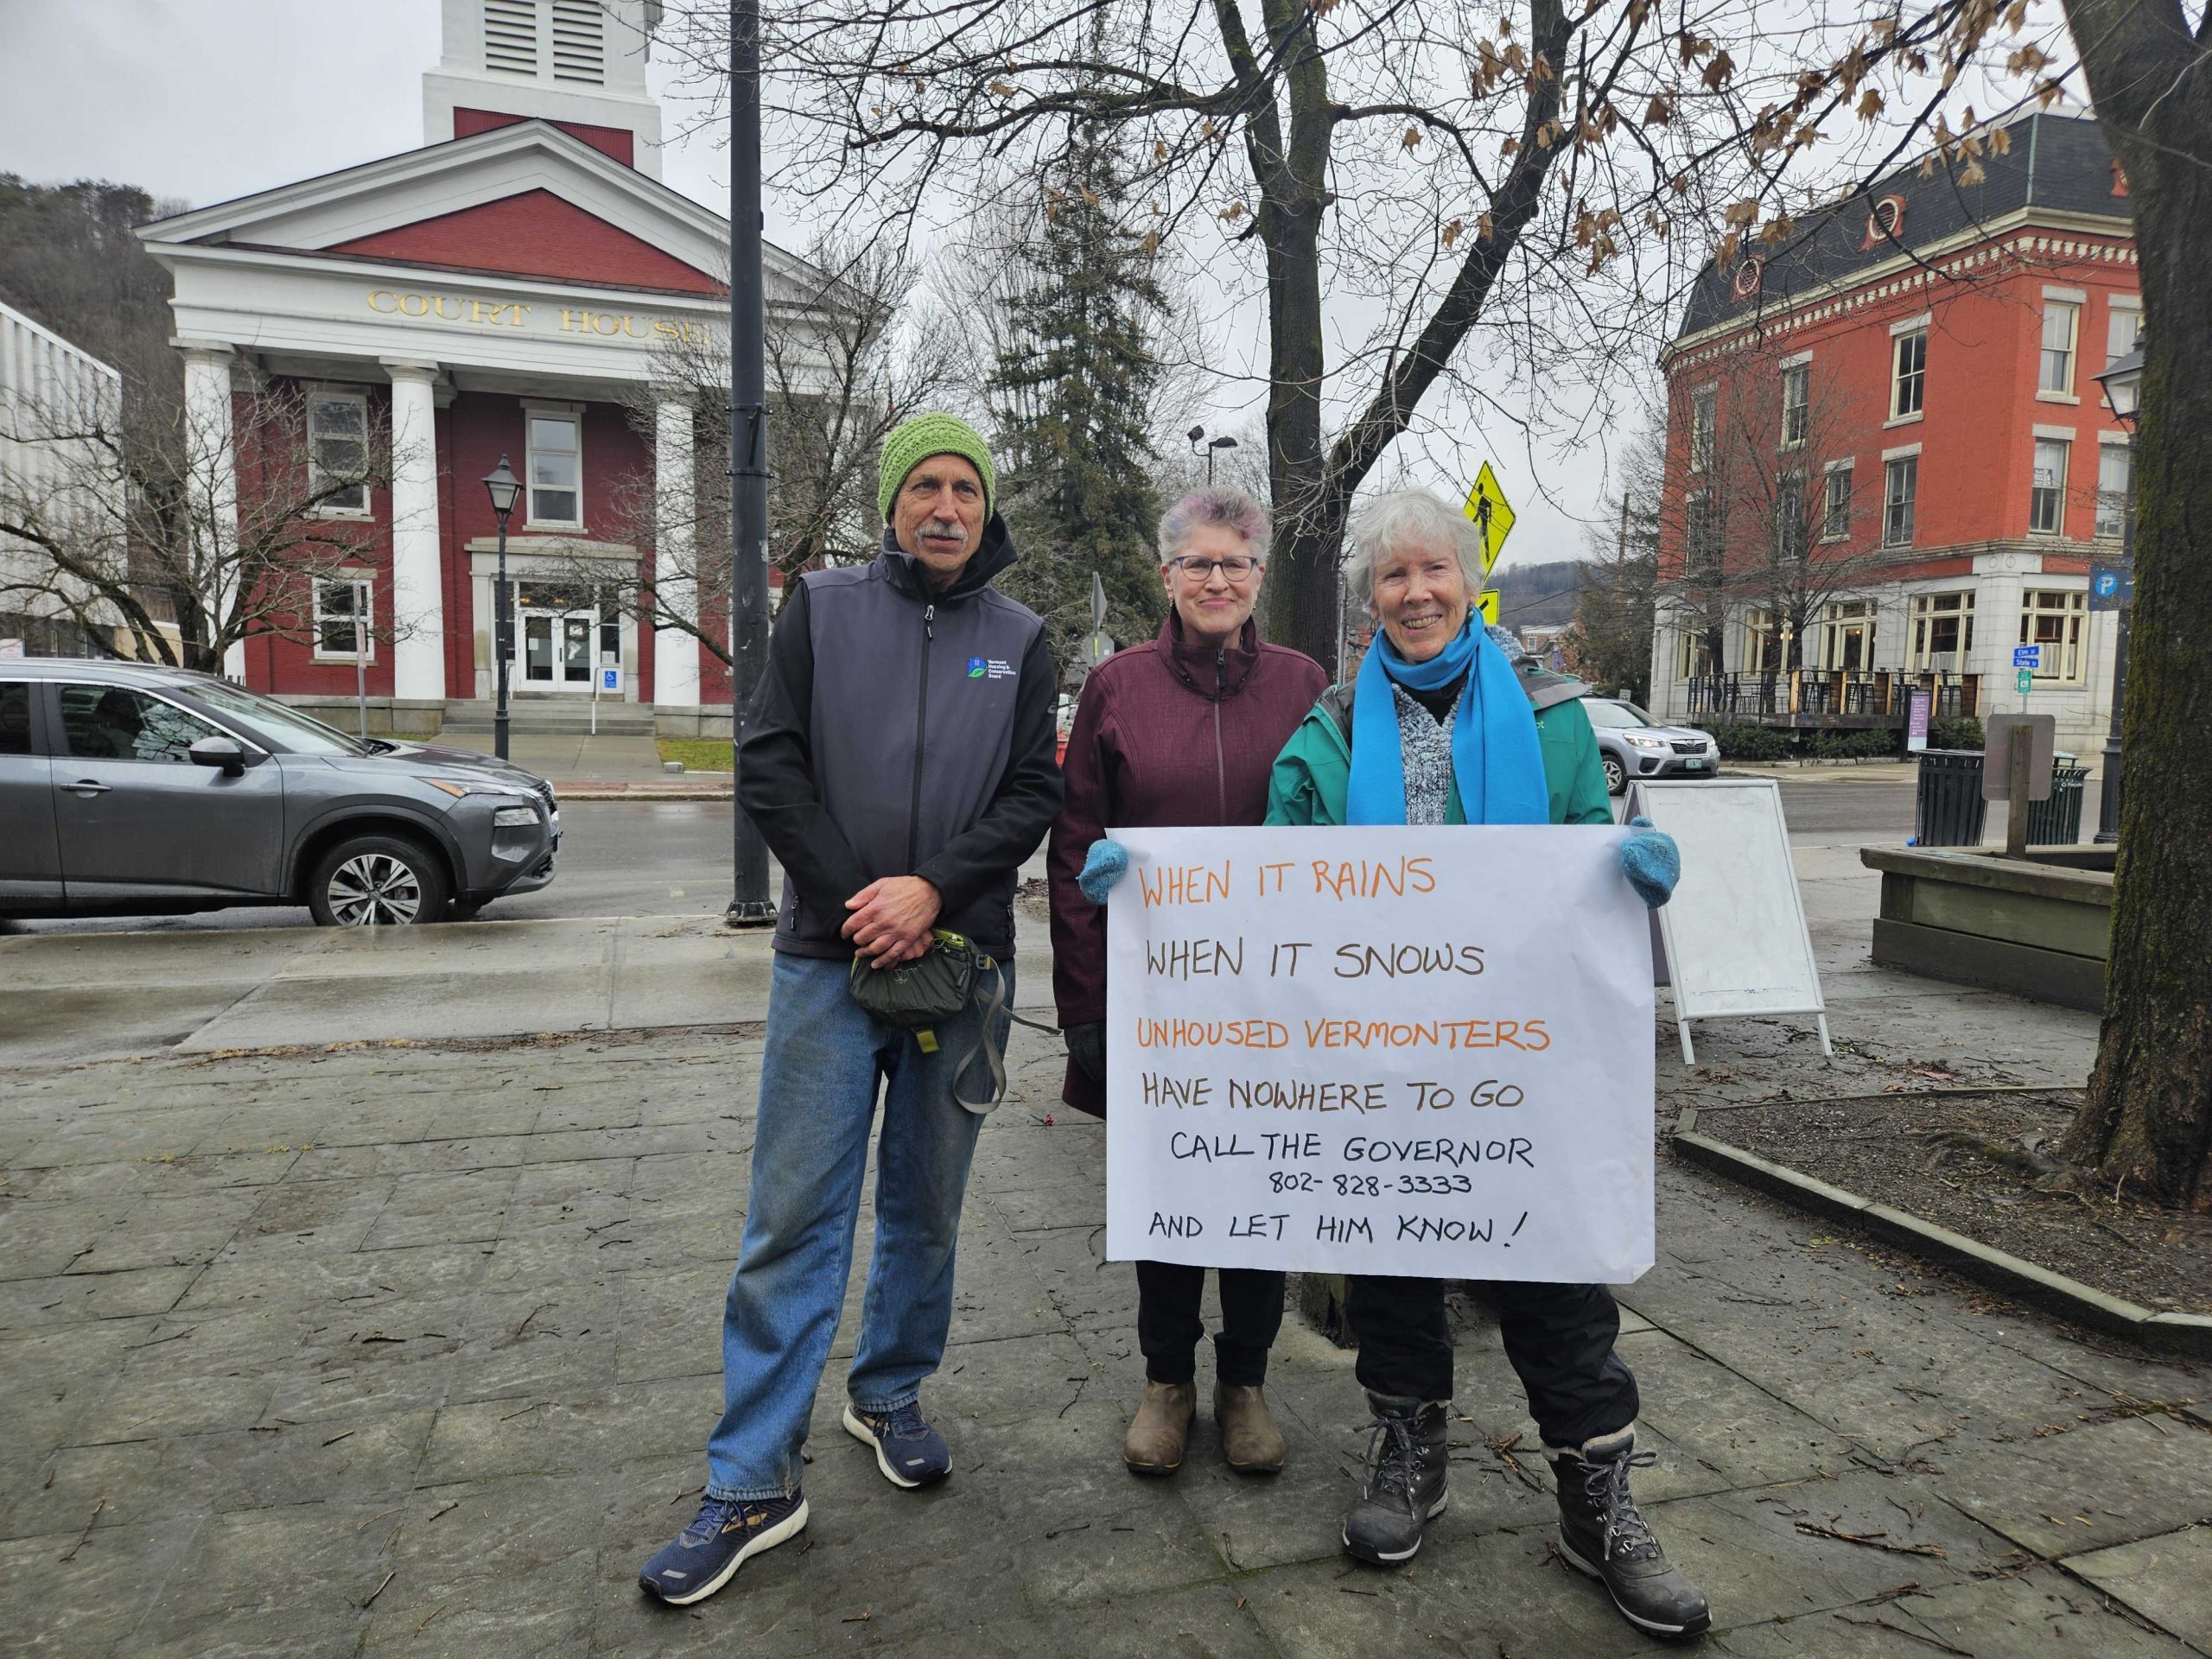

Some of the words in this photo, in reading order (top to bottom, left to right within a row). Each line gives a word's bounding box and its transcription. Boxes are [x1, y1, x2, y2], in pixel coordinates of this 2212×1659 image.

[367, 290, 532, 327] COURT
[558, 308, 709, 346] HOUSE
[1139, 860, 1230, 908] WHEN
[1259, 863, 1295, 896] IT
[1312, 856, 1436, 901] RAINS
[1147, 937, 1243, 982] WHEN
[1270, 943, 1313, 977] IT
[1334, 943, 1485, 978] SNOWS
[1138, 1018, 1289, 1048] UNHOUSED
[1305, 1019, 1550, 1051] VERMONTERS
[1142, 1072, 1213, 1109] HAVE
[1229, 1078, 1387, 1115] NOWHERE
[1407, 1082, 1455, 1111] TO
[1471, 1080, 1524, 1108] GO
[1171, 1132, 1255, 1163] CALL
[1261, 1133, 1322, 1161] THE
[1344, 1136, 1534, 1168] GOVERNOR
[1148, 1211, 1204, 1239] AND
[1230, 1214, 1290, 1241] LET
[1316, 1215, 1373, 1243] HIM
